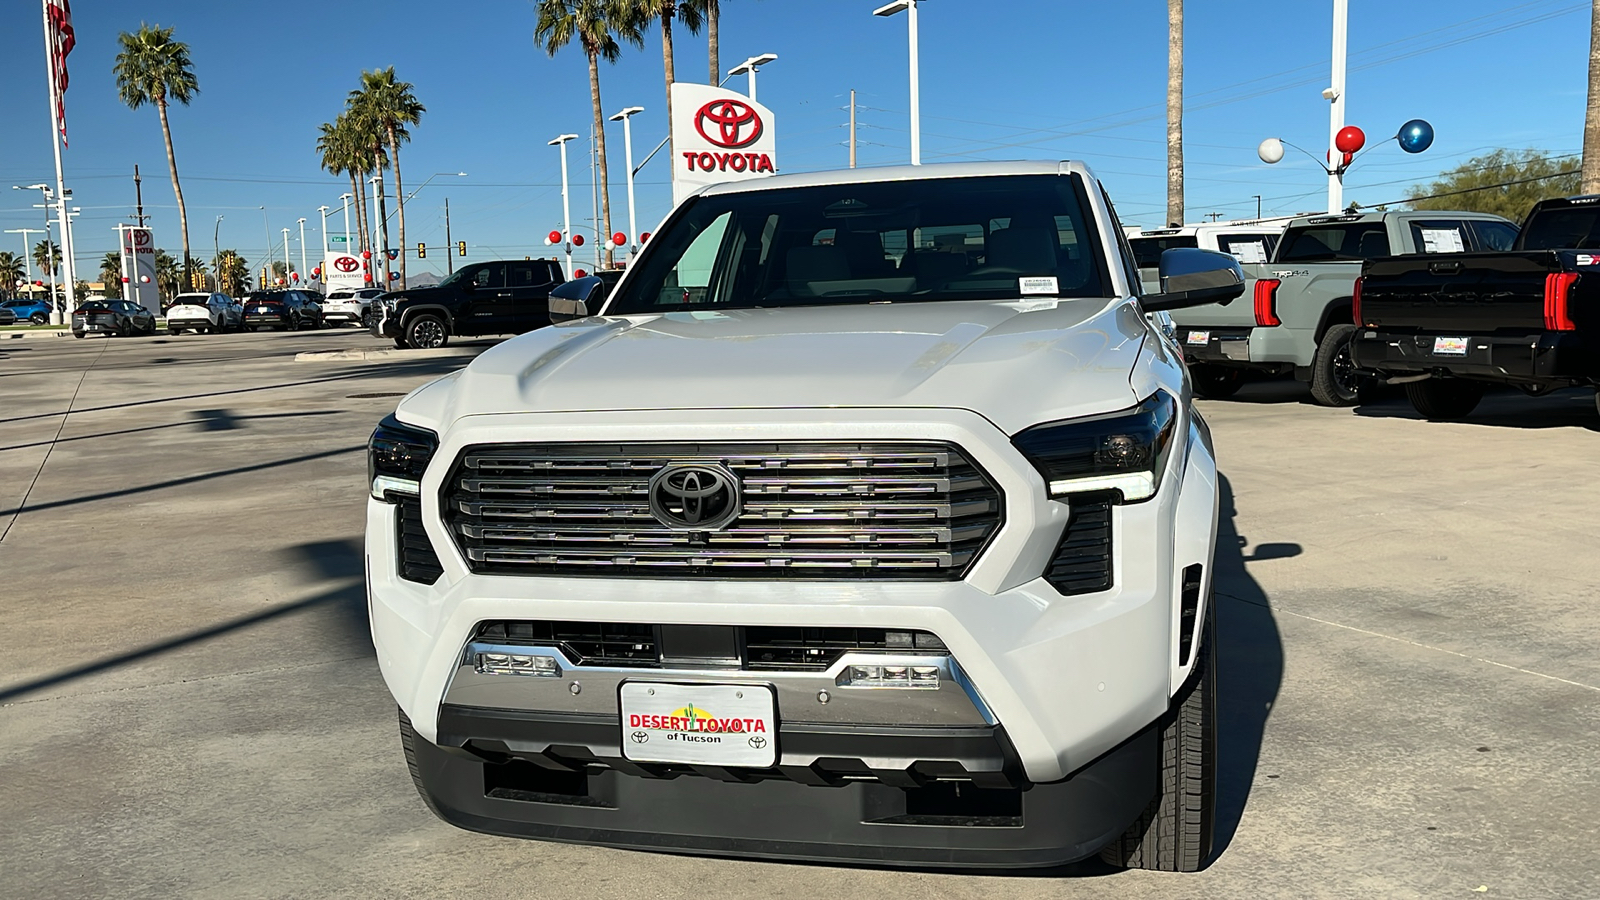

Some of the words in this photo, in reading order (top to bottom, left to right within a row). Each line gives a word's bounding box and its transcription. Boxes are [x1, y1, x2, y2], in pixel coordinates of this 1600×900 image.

[683, 152, 775, 173] TOYOTA
[630, 714, 690, 731] DESERT
[695, 718, 766, 733] TOYOTA
[667, 733, 679, 741] of
[680, 733, 721, 743] Tucson
